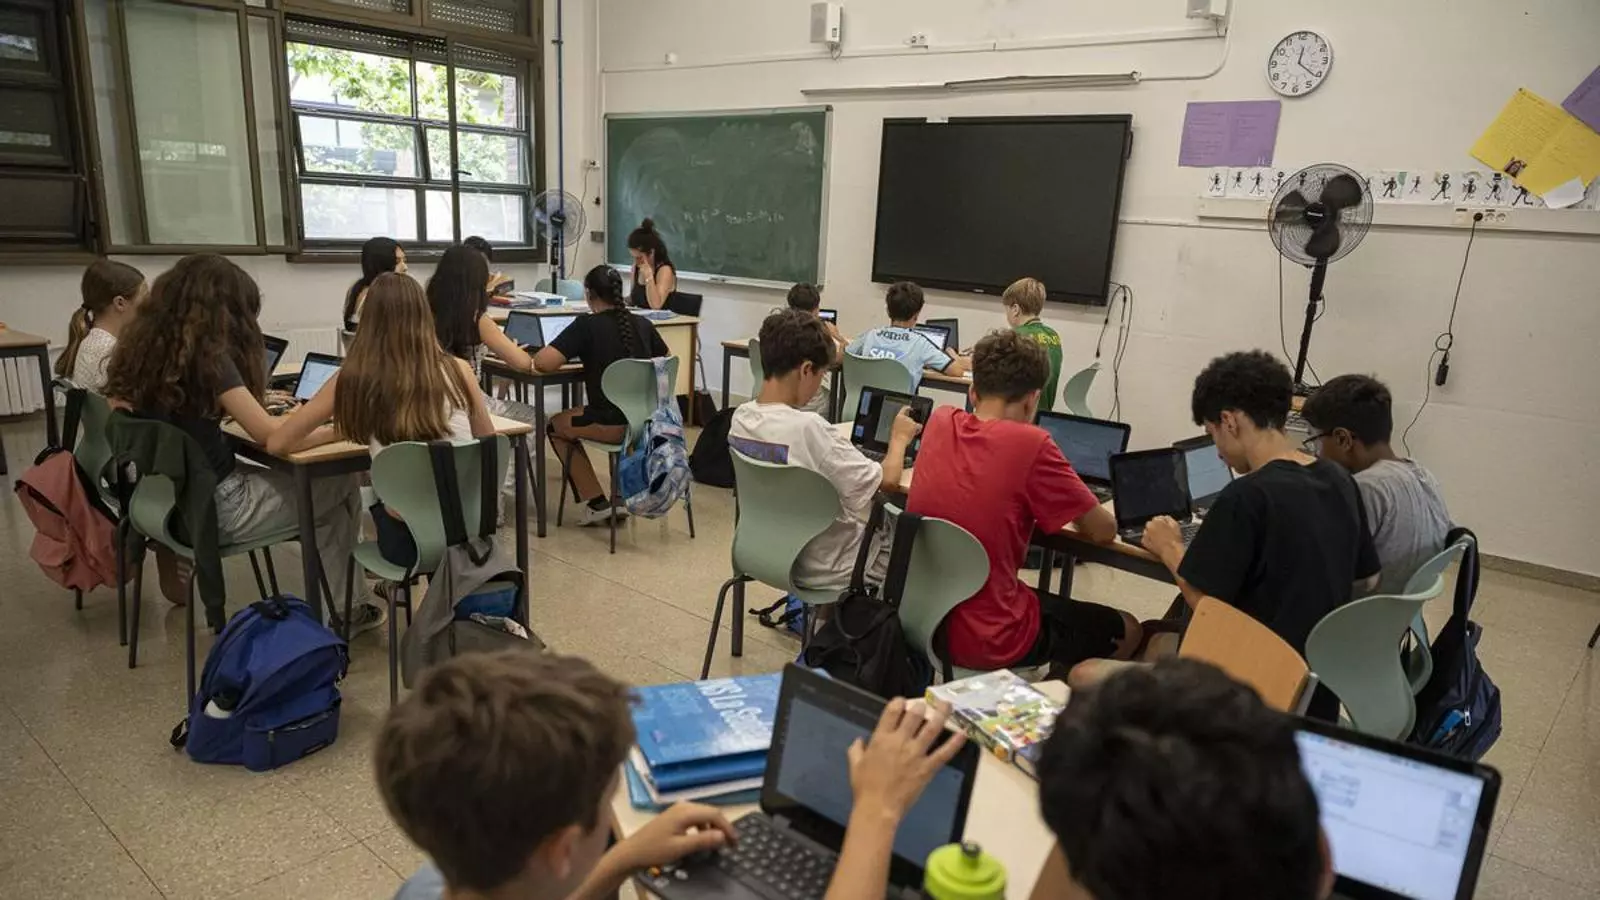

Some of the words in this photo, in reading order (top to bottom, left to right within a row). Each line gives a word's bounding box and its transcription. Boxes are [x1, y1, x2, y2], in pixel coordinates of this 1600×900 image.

[1298, 33, 1308, 41] 12
[1286, 38, 1293, 46] 11
[1276, 47, 1286, 56] 10
[1319, 44, 1328, 53] 2
[1271, 60, 1278, 69] 9
[1322, 56, 1329, 65] 3
[1272, 73, 1280, 81] 8
[1280, 82, 1287, 90] 7
[1305, 80, 1313, 88] 5
[1291, 85, 1300, 93] 6
